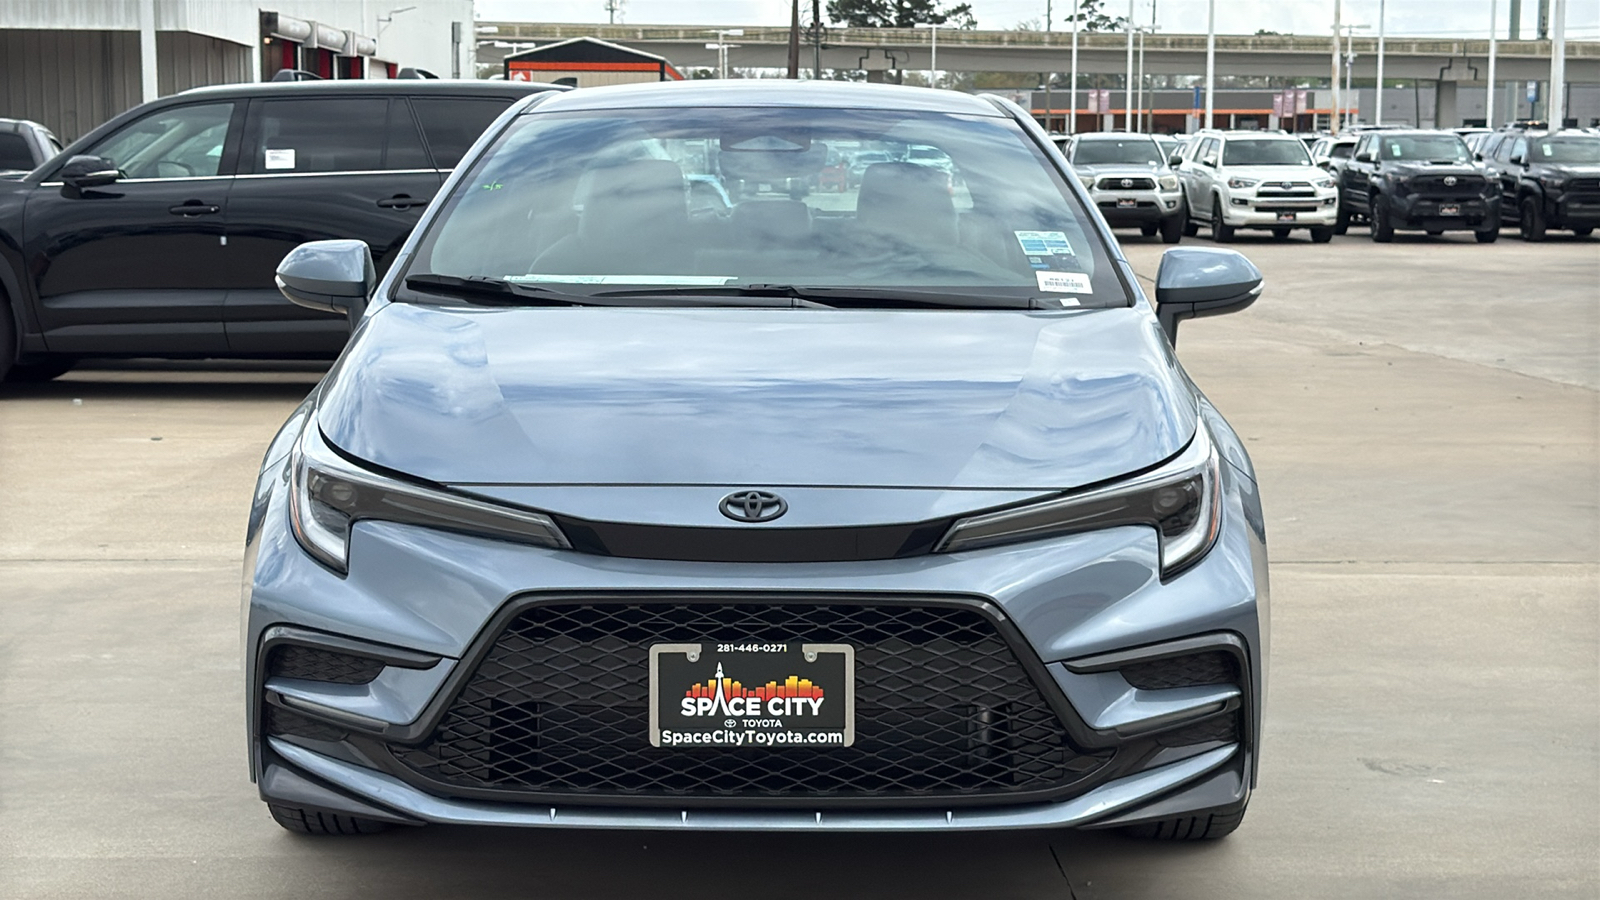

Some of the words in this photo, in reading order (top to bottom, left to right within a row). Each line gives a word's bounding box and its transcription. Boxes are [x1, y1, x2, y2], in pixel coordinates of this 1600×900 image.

[717, 643, 787, 653] 281-446-0271
[681, 697, 761, 716] SPACE
[767, 697, 825, 716] CITY
[742, 719, 783, 728] TOYOTA
[662, 730, 843, 746] SpaceCityToyota.com
